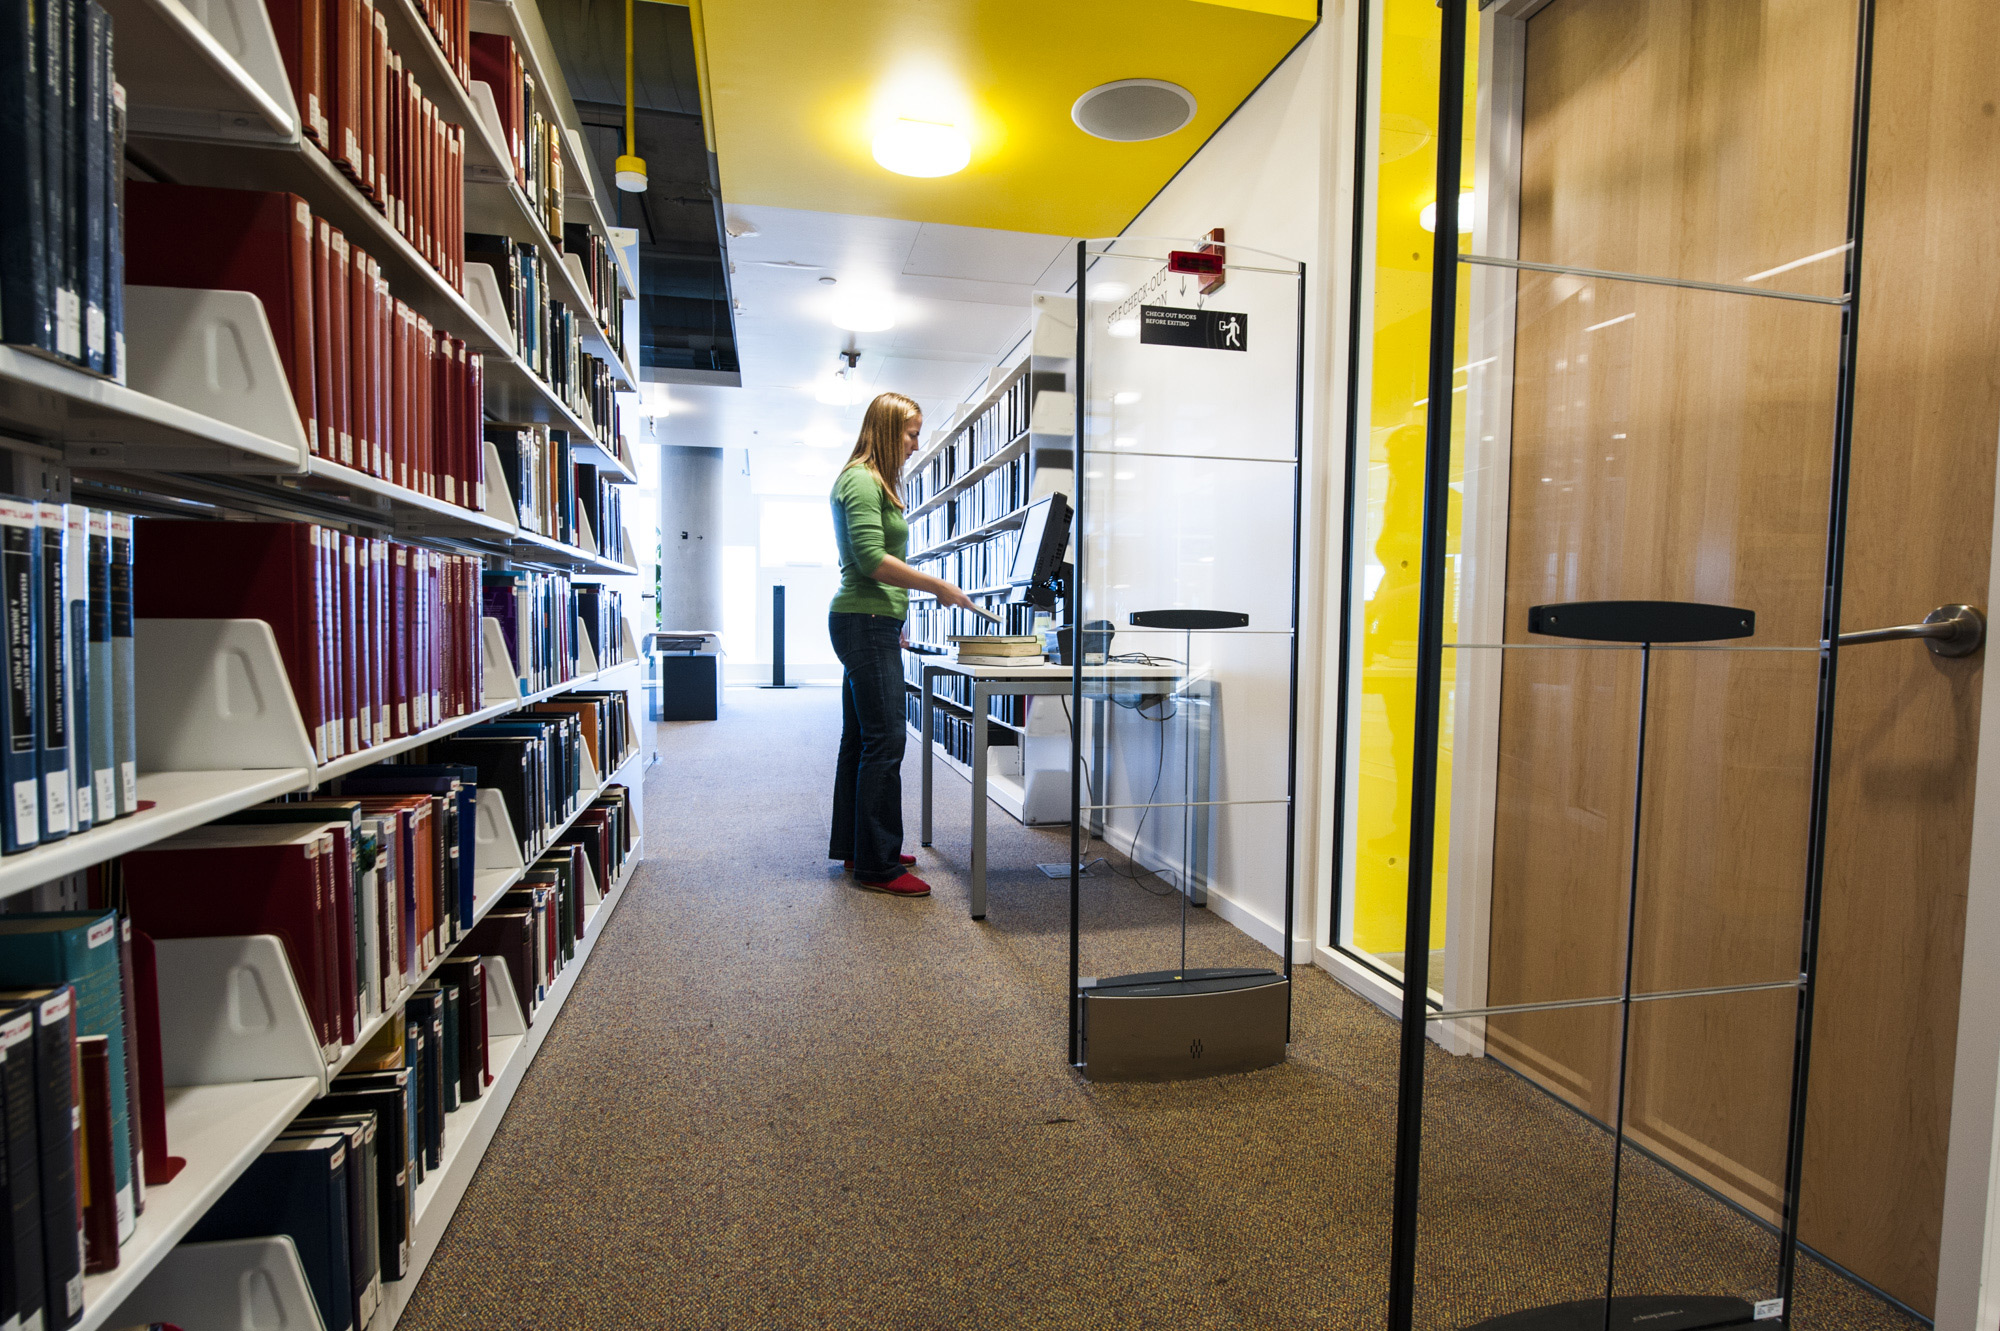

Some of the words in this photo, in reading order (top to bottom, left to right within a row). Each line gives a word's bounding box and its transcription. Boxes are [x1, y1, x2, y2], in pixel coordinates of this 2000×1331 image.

[1123, 264, 1168, 316] CHECK-OUT
[1167, 319, 1190, 327] EXITING
[53, 562, 61, 579] LAW
[20, 573, 29, 613] RESEARCH
[11, 608, 21, 645] JOURNAL
[21, 615, 29, 626] IN
[21, 628, 30, 645] LAW
[12, 647, 21, 659] OF
[22, 647, 30, 666] AND
[13, 661, 23, 691] POLICY
[55, 703, 63, 733] JUSTICE
